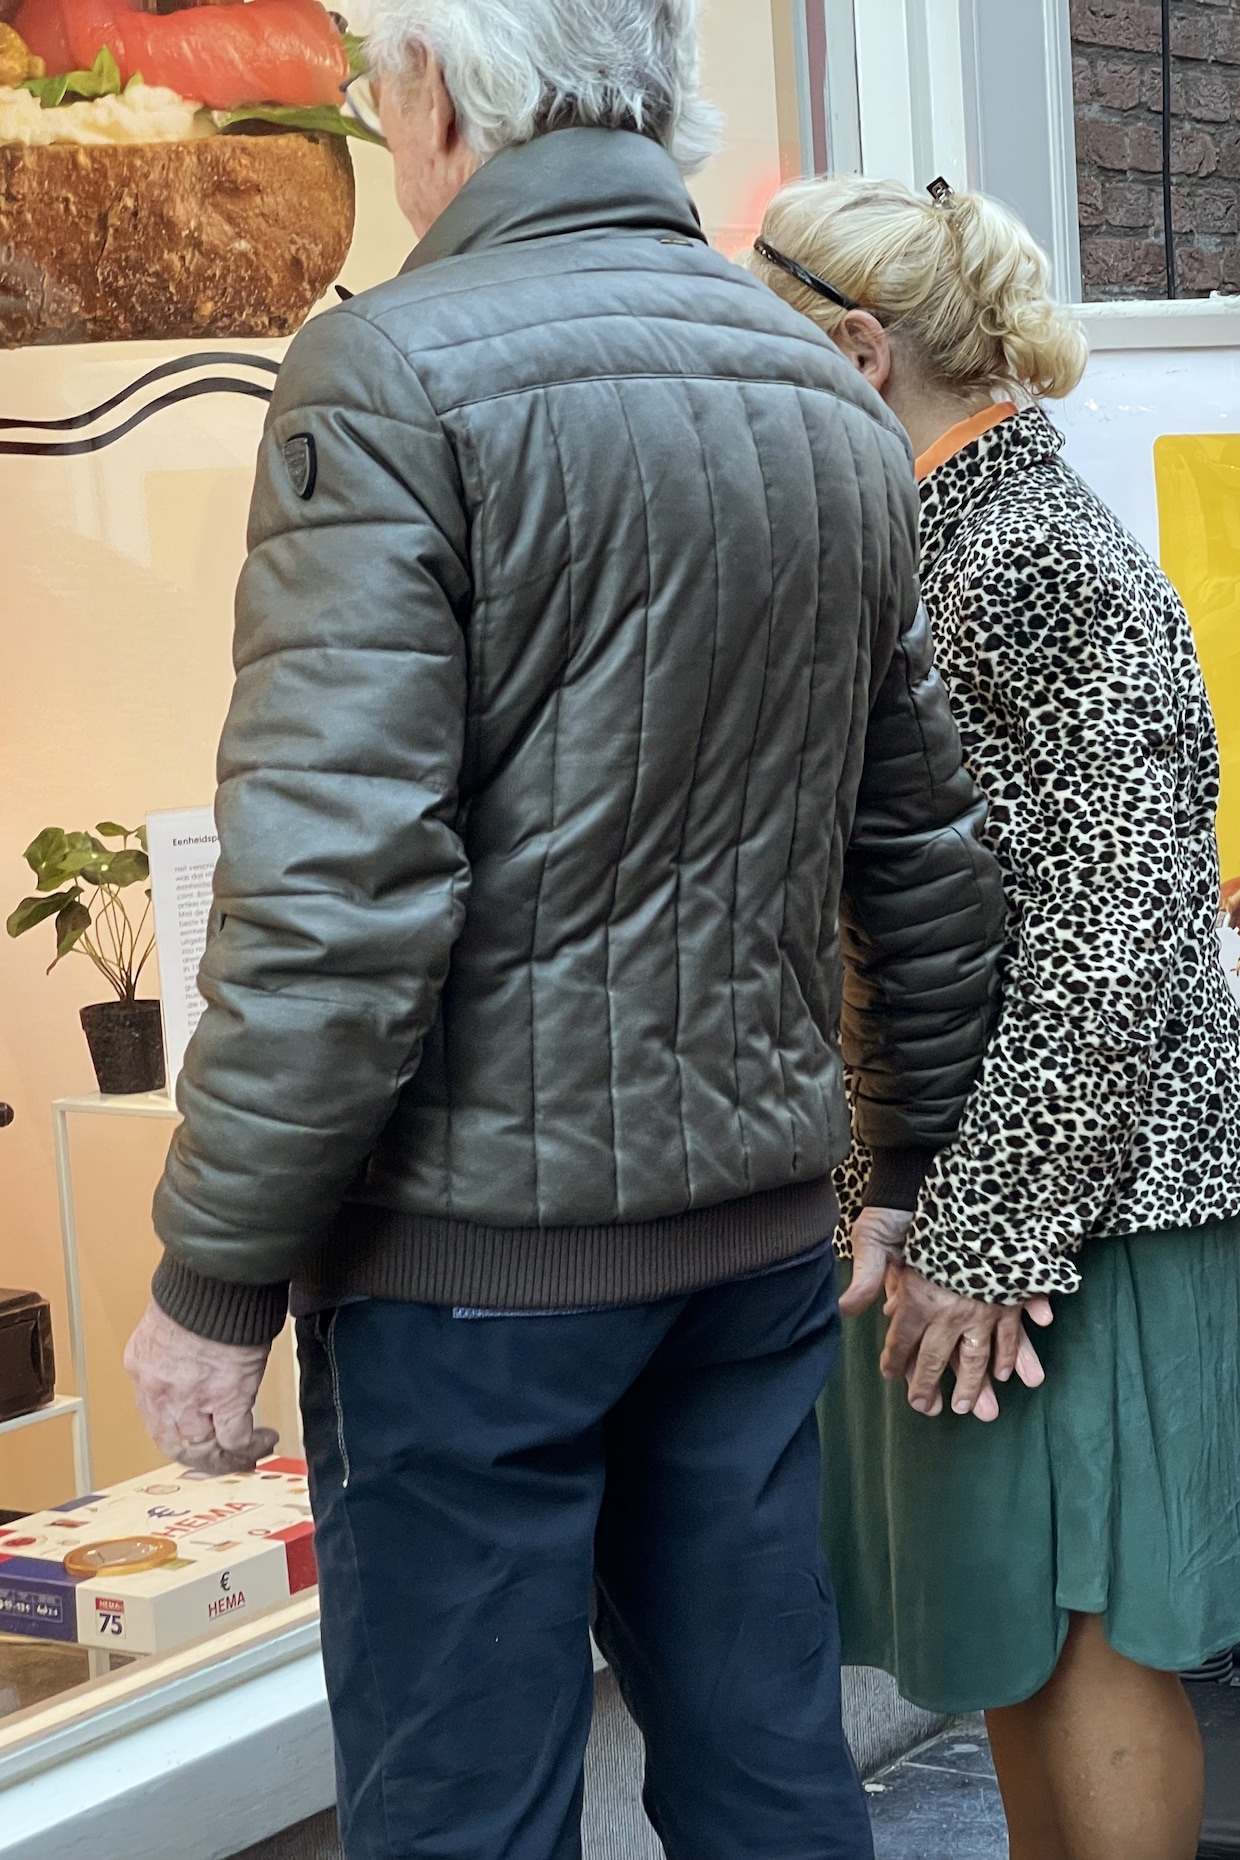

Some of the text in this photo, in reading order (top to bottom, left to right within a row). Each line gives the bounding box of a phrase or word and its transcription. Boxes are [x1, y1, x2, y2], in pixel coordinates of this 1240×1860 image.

[172, 835, 219, 846] Eenheidsp
[208, 1590, 246, 1618] HEMA
[99, 1612, 123, 1635] 75
